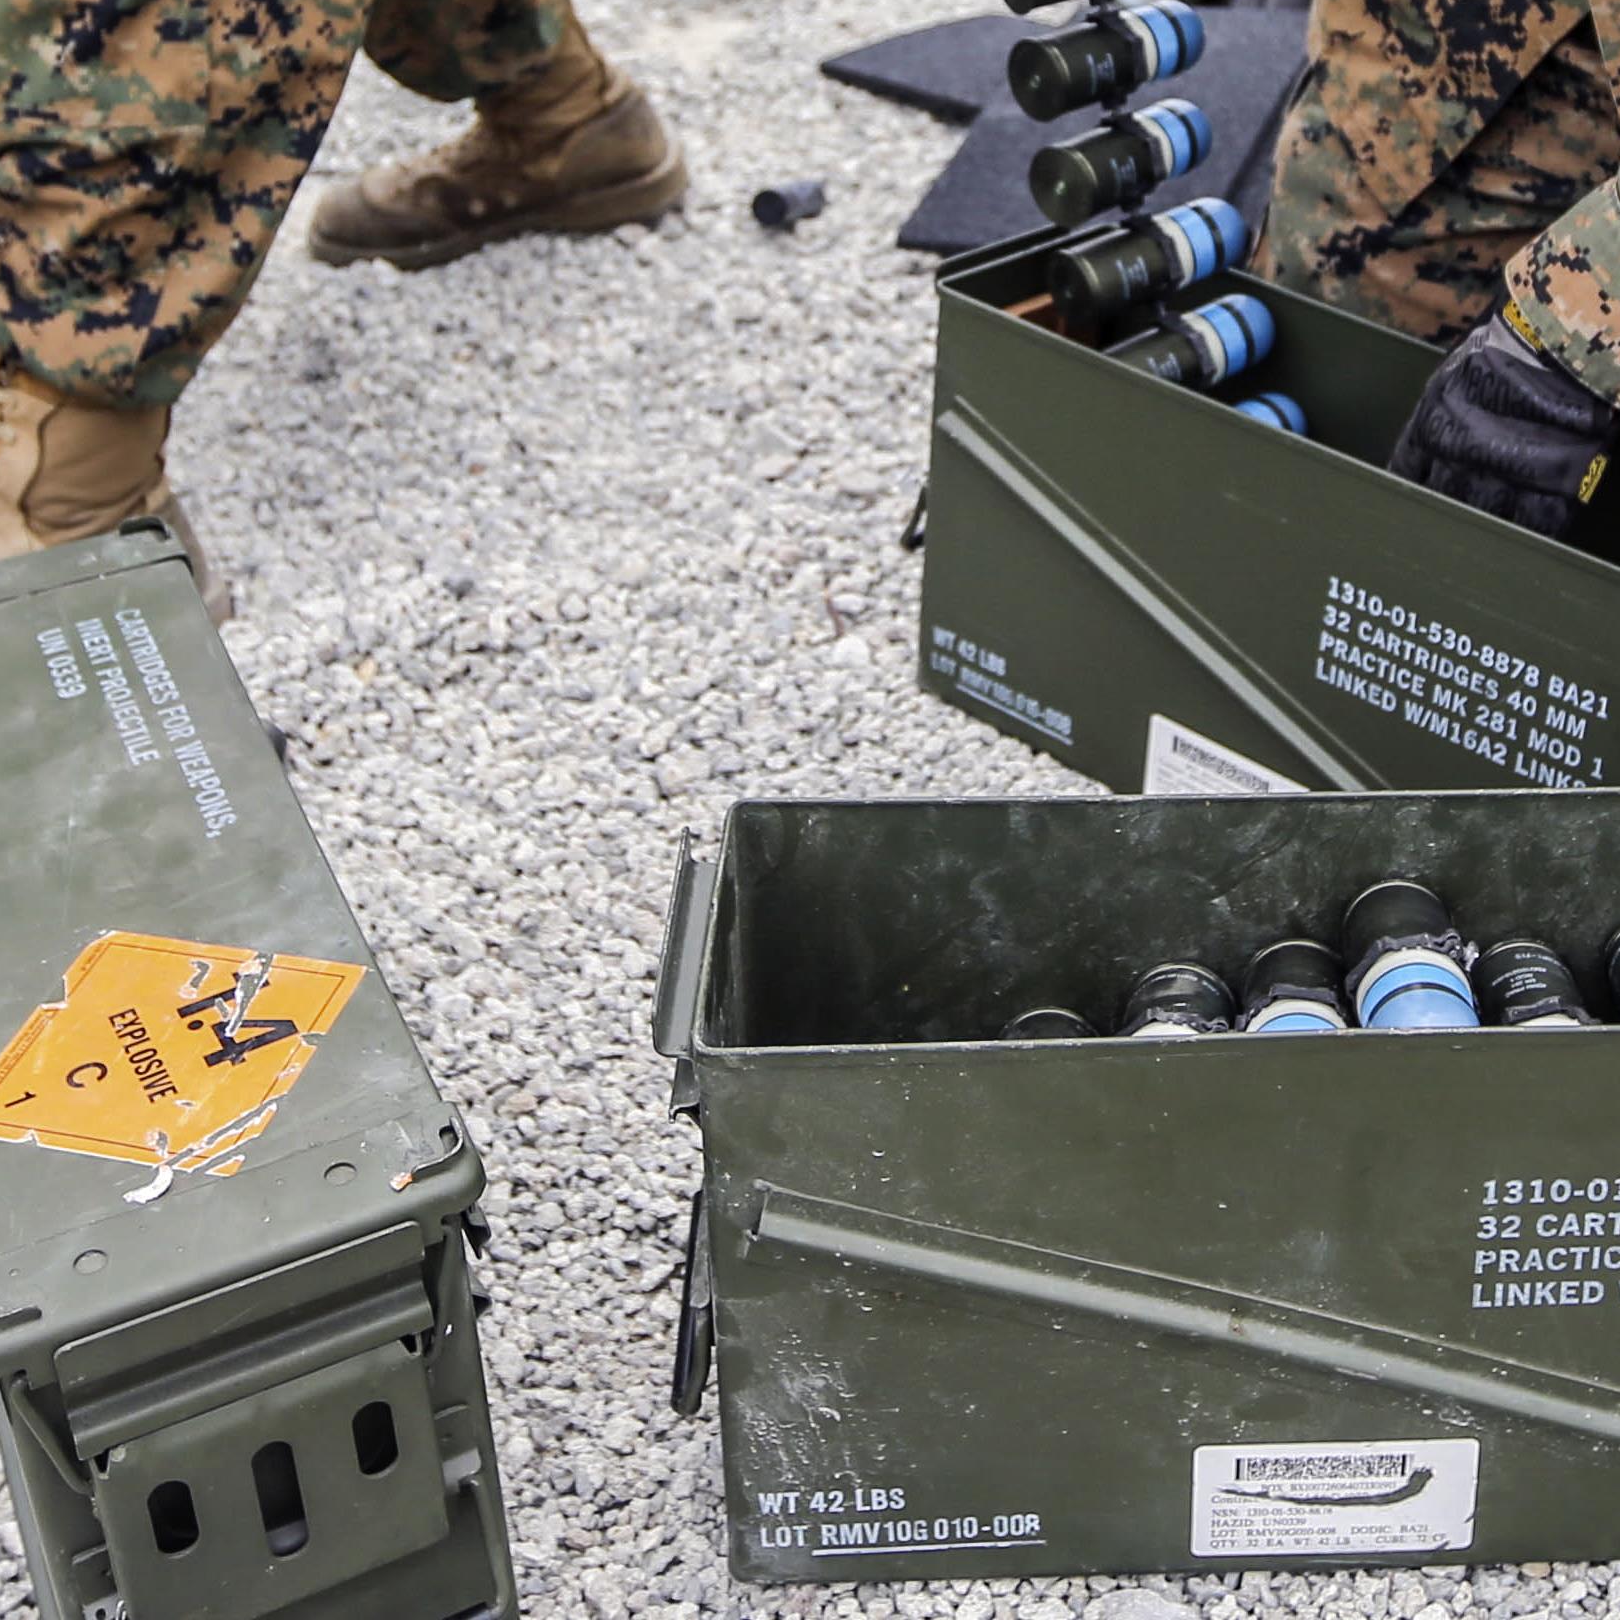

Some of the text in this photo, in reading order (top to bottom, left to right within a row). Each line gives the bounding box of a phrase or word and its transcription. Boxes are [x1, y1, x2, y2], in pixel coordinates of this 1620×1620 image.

[36, 627, 87, 700] UN 0339
[75, 617, 161, 766] INERT PROJECTILE
[115, 608, 180, 706] CARTRIDGES
[157, 704, 195, 743] FOR
[1323, 605, 1587, 740] 32 CARTRIDGES 40 MM
[1327, 576, 1609, 719] 1310-01-530-8878 BA21
[1315, 658, 1397, 712] LINKED
[1404, 700, 1508, 765] W/M16A2
[1319, 631, 1603, 780] PRACTICE MK 281 MOD 1
[108, 1008, 178, 1105] EXPLOSIVE
[176, 972, 299, 1067] 1.4
[5, 1091, 37, 1109] 1
[66, 1061, 108, 1089] C
[1477, 1214, 1521, 1239] 32
[1472, 1281, 1604, 1308] LINKED
[758, 1488, 905, 1515] WT 42 LBS
[759, 1525, 807, 1548] LOT
